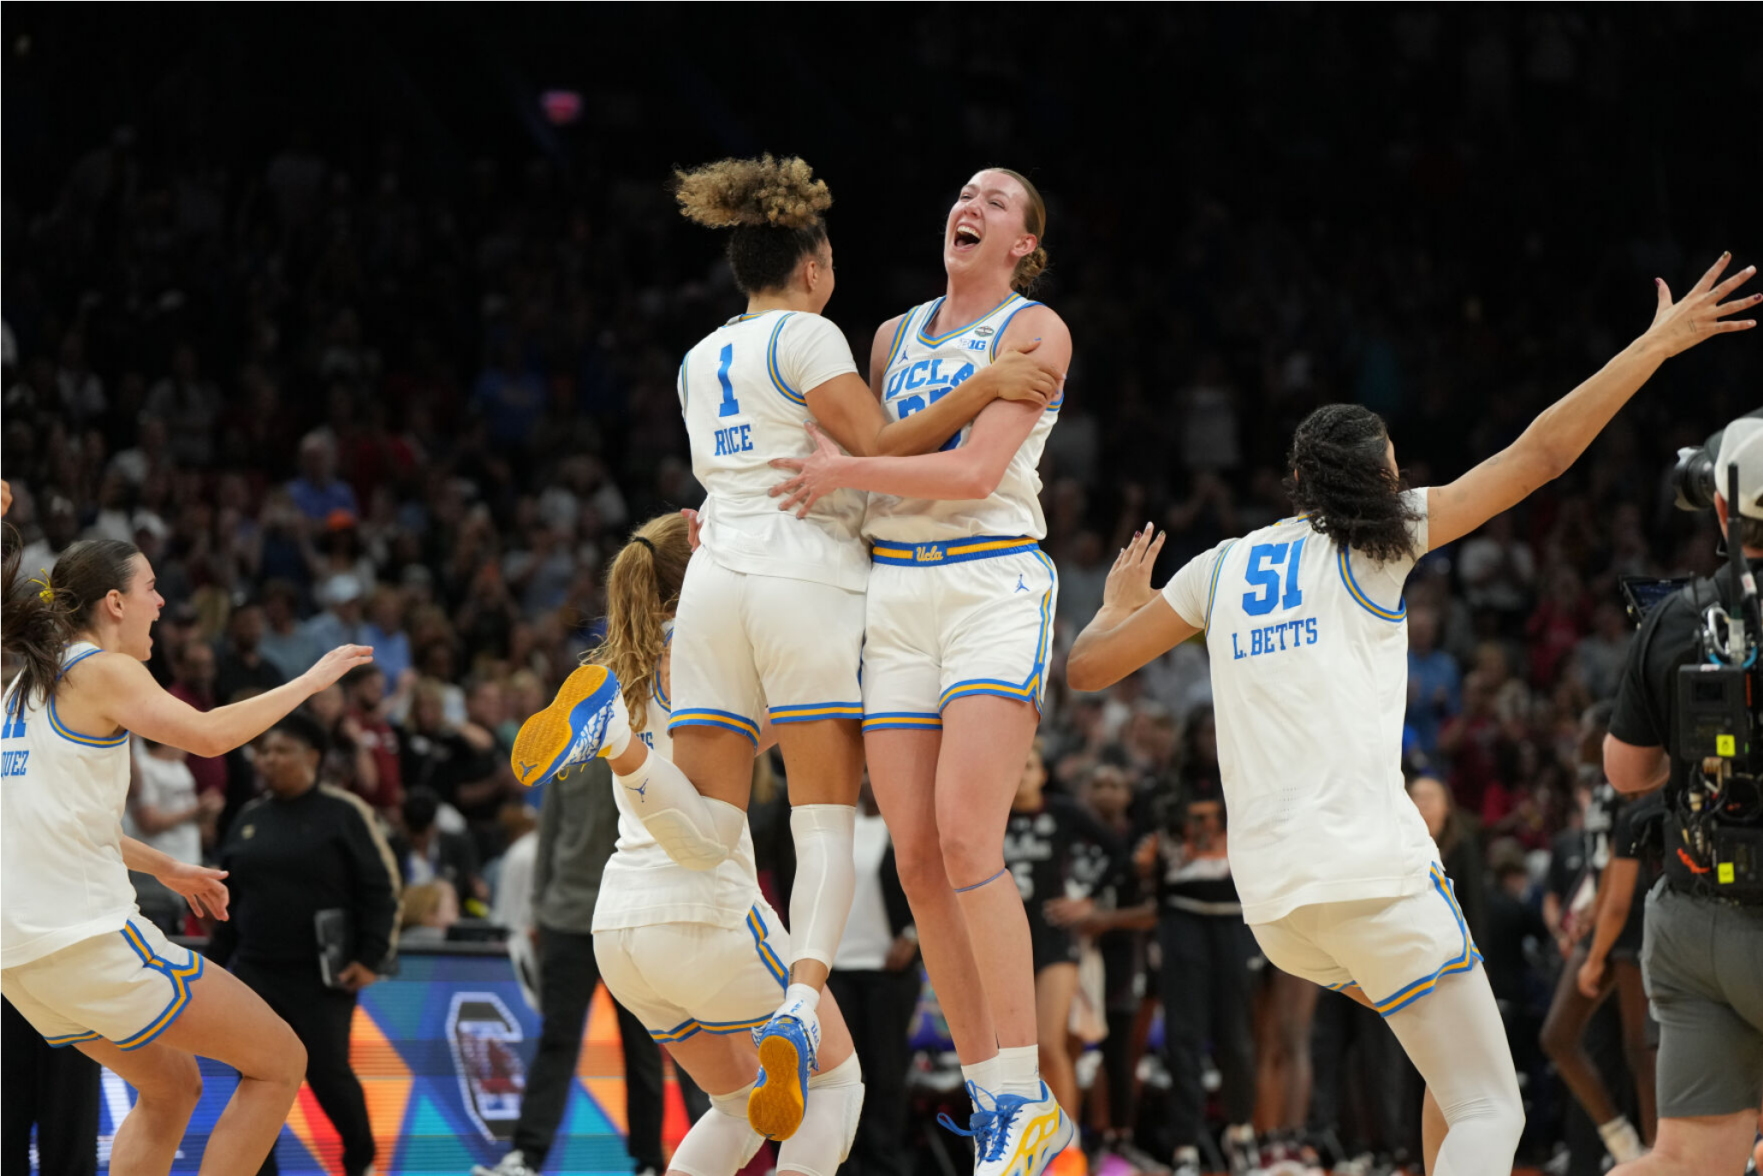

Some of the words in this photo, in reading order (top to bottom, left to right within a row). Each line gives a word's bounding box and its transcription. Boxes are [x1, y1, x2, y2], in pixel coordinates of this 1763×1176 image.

[717, 343, 740, 418] 1
[714, 423, 754, 457] RICE
[916, 545, 944, 562] Ucla
[1241, 535, 1307, 617] 51
